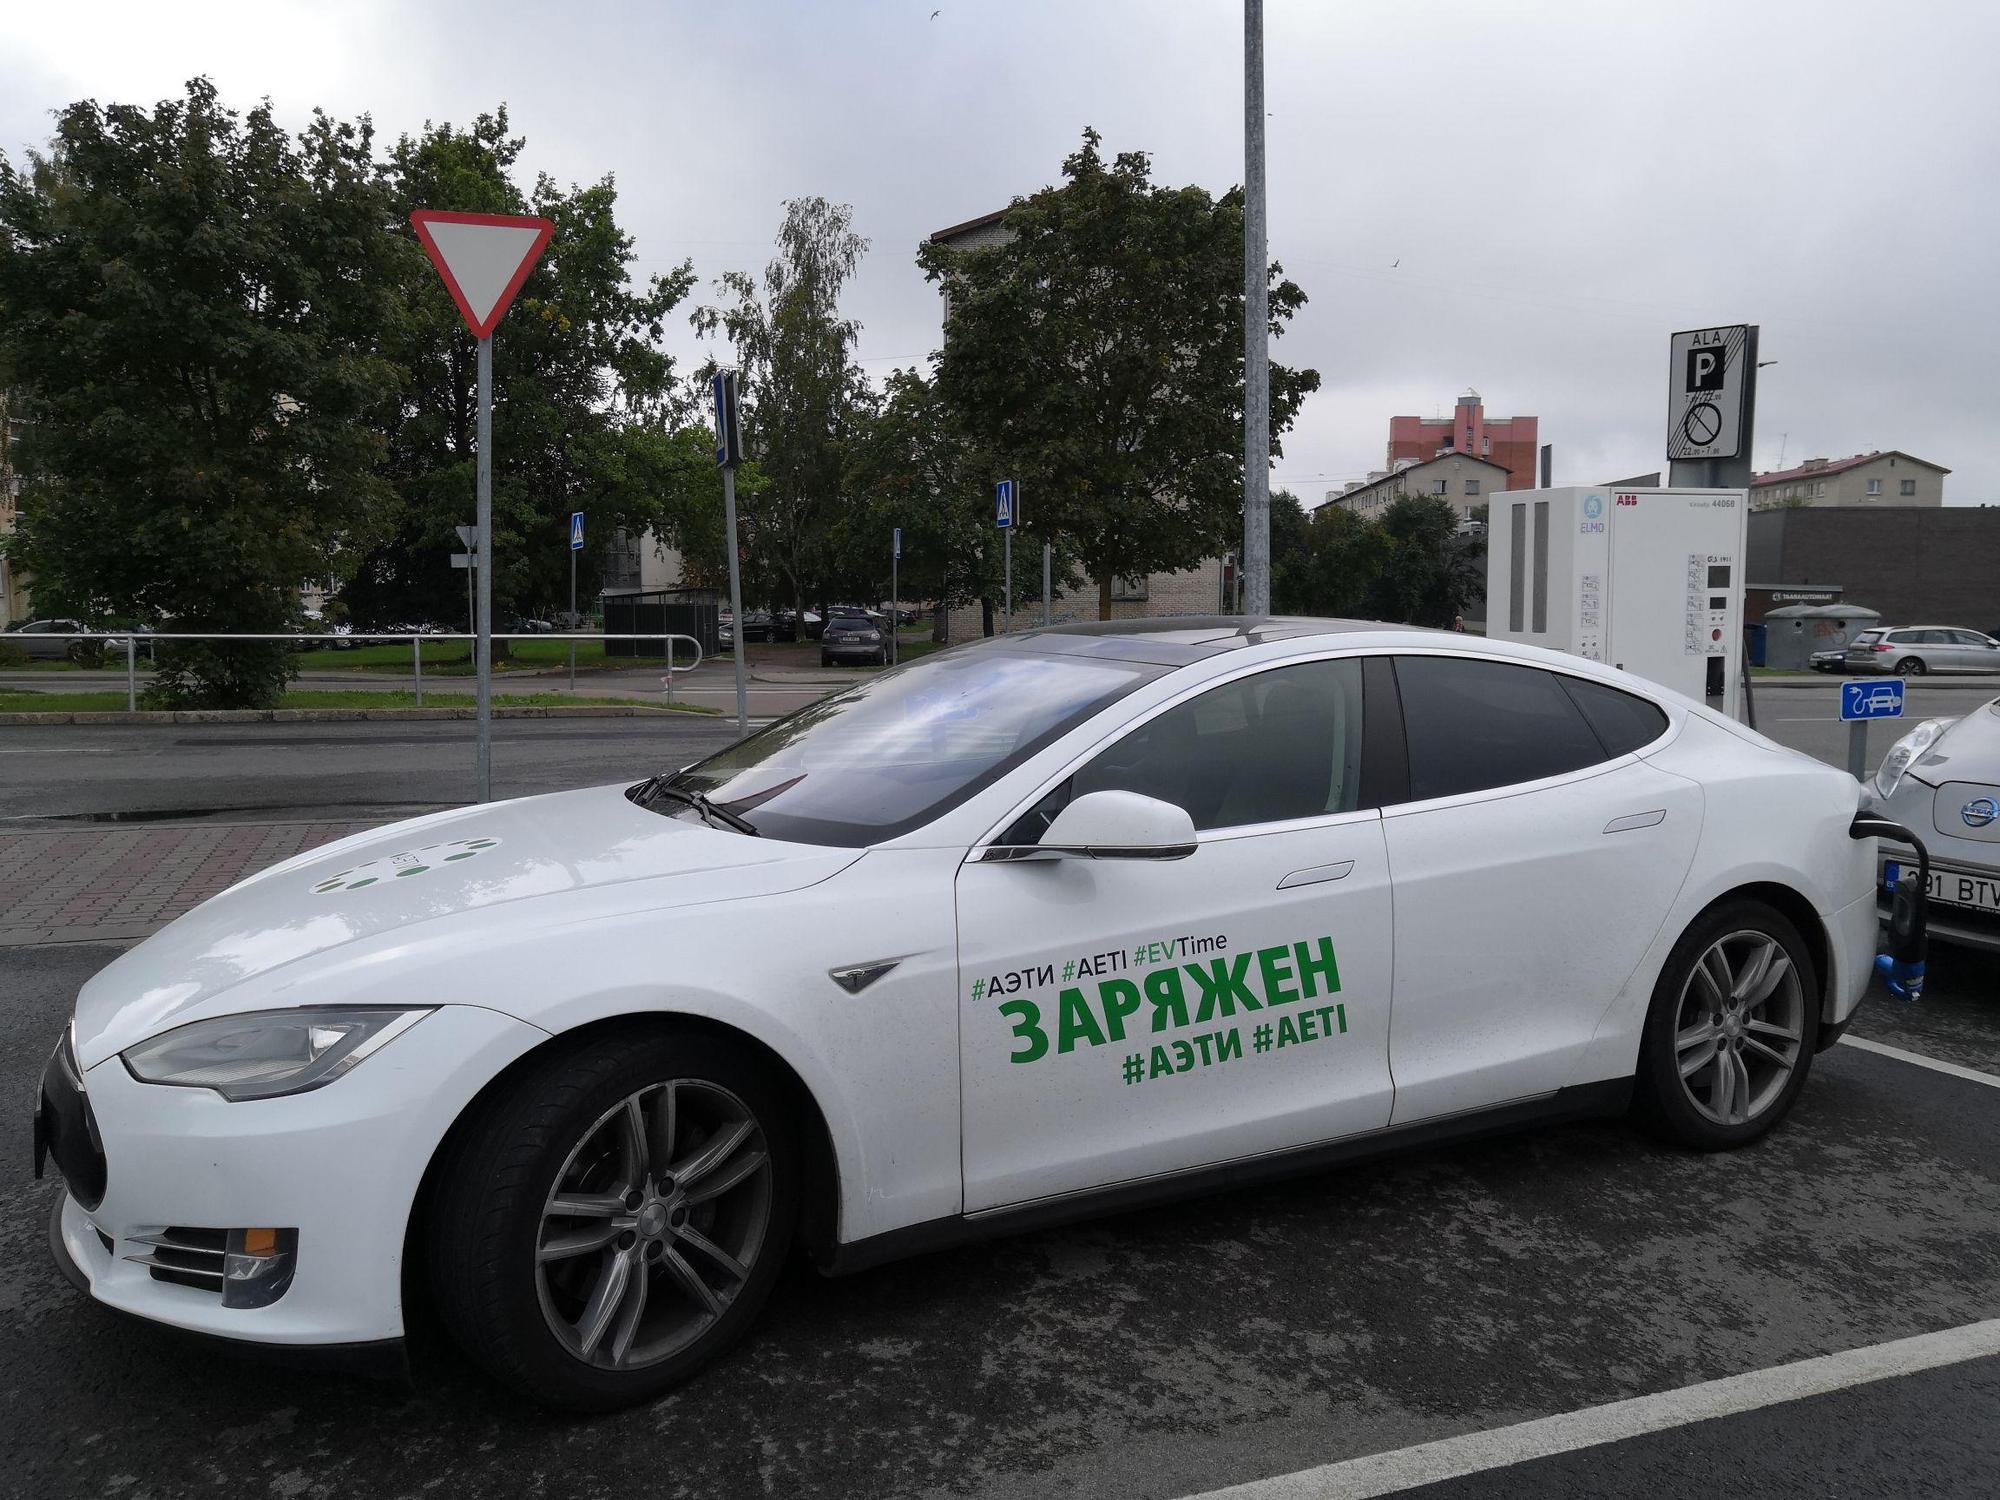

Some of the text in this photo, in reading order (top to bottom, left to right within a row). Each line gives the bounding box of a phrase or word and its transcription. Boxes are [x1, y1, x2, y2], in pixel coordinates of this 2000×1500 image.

[1692, 331, 1721, 346] ALA
[1695, 352, 1716, 387] P
[1616, 495, 1637, 506] ABB
[1580, 522, 1605, 533] ELMO
[971, 935, 1228, 1001] #АЭТИ #AETI #EVTime
[997, 935, 1342, 1064] ЗАРЯЖЕН
[1122, 1003, 1348, 1086] #АЭТИ #AETI
